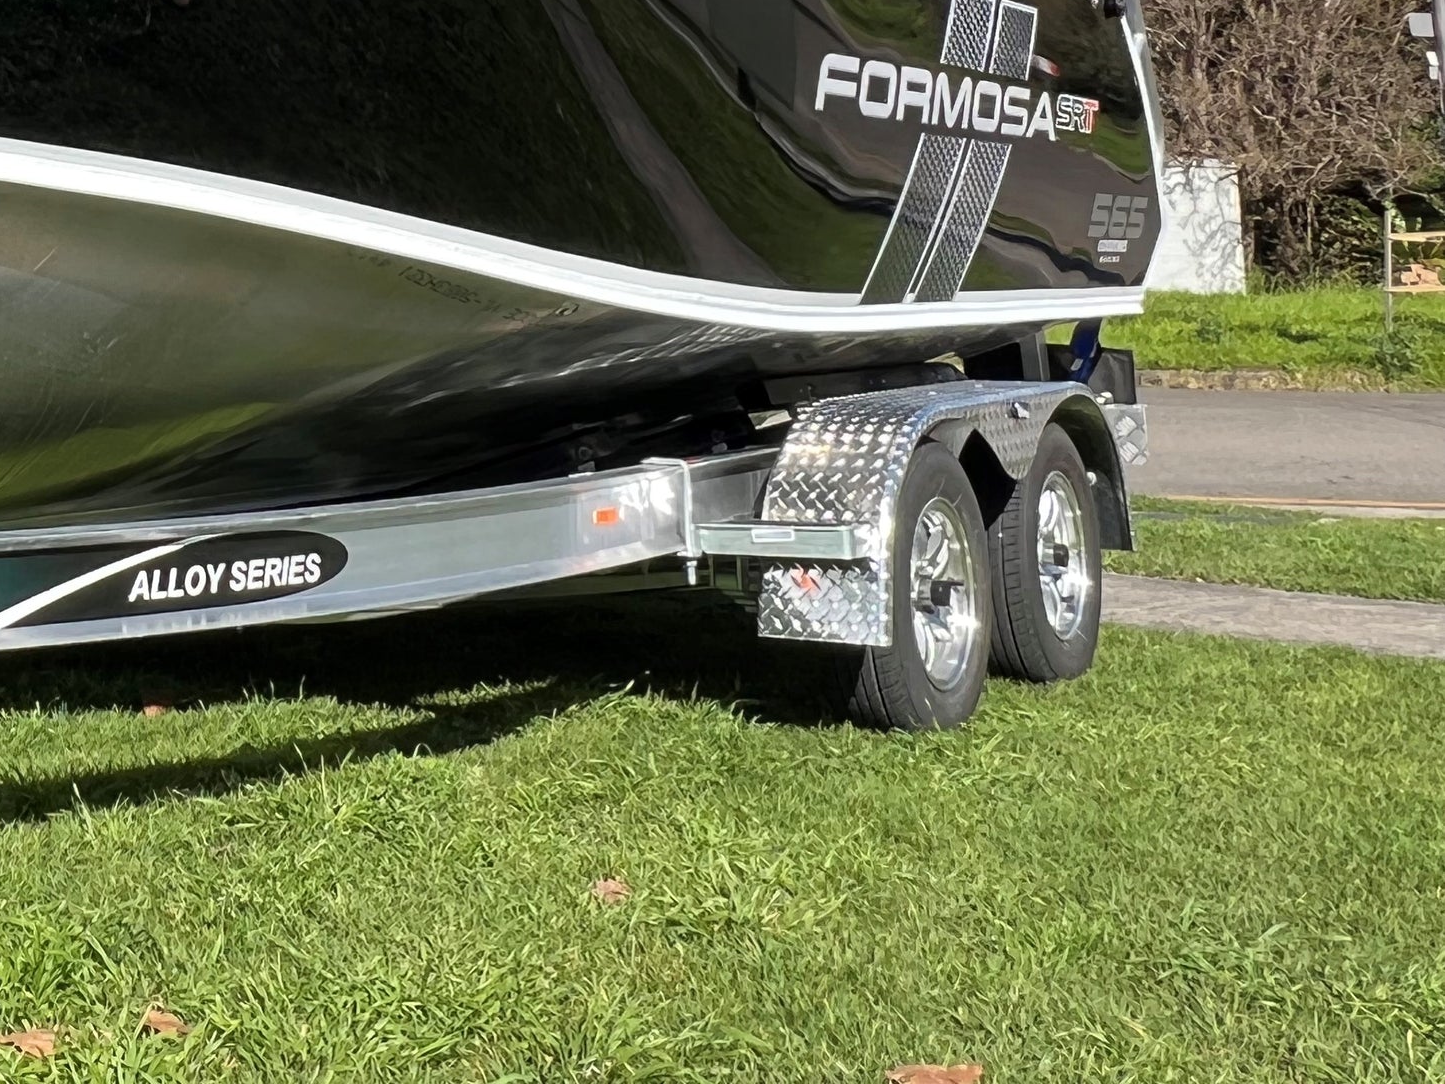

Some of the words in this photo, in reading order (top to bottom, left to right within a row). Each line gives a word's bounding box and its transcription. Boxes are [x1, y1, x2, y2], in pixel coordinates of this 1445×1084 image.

[814, 53, 1057, 141] FORMOSA
[1055, 93, 1100, 134] SRT
[1087, 192, 1149, 239] 565
[127, 562, 226, 603] ALLOY
[228, 552, 322, 592] SERIES
